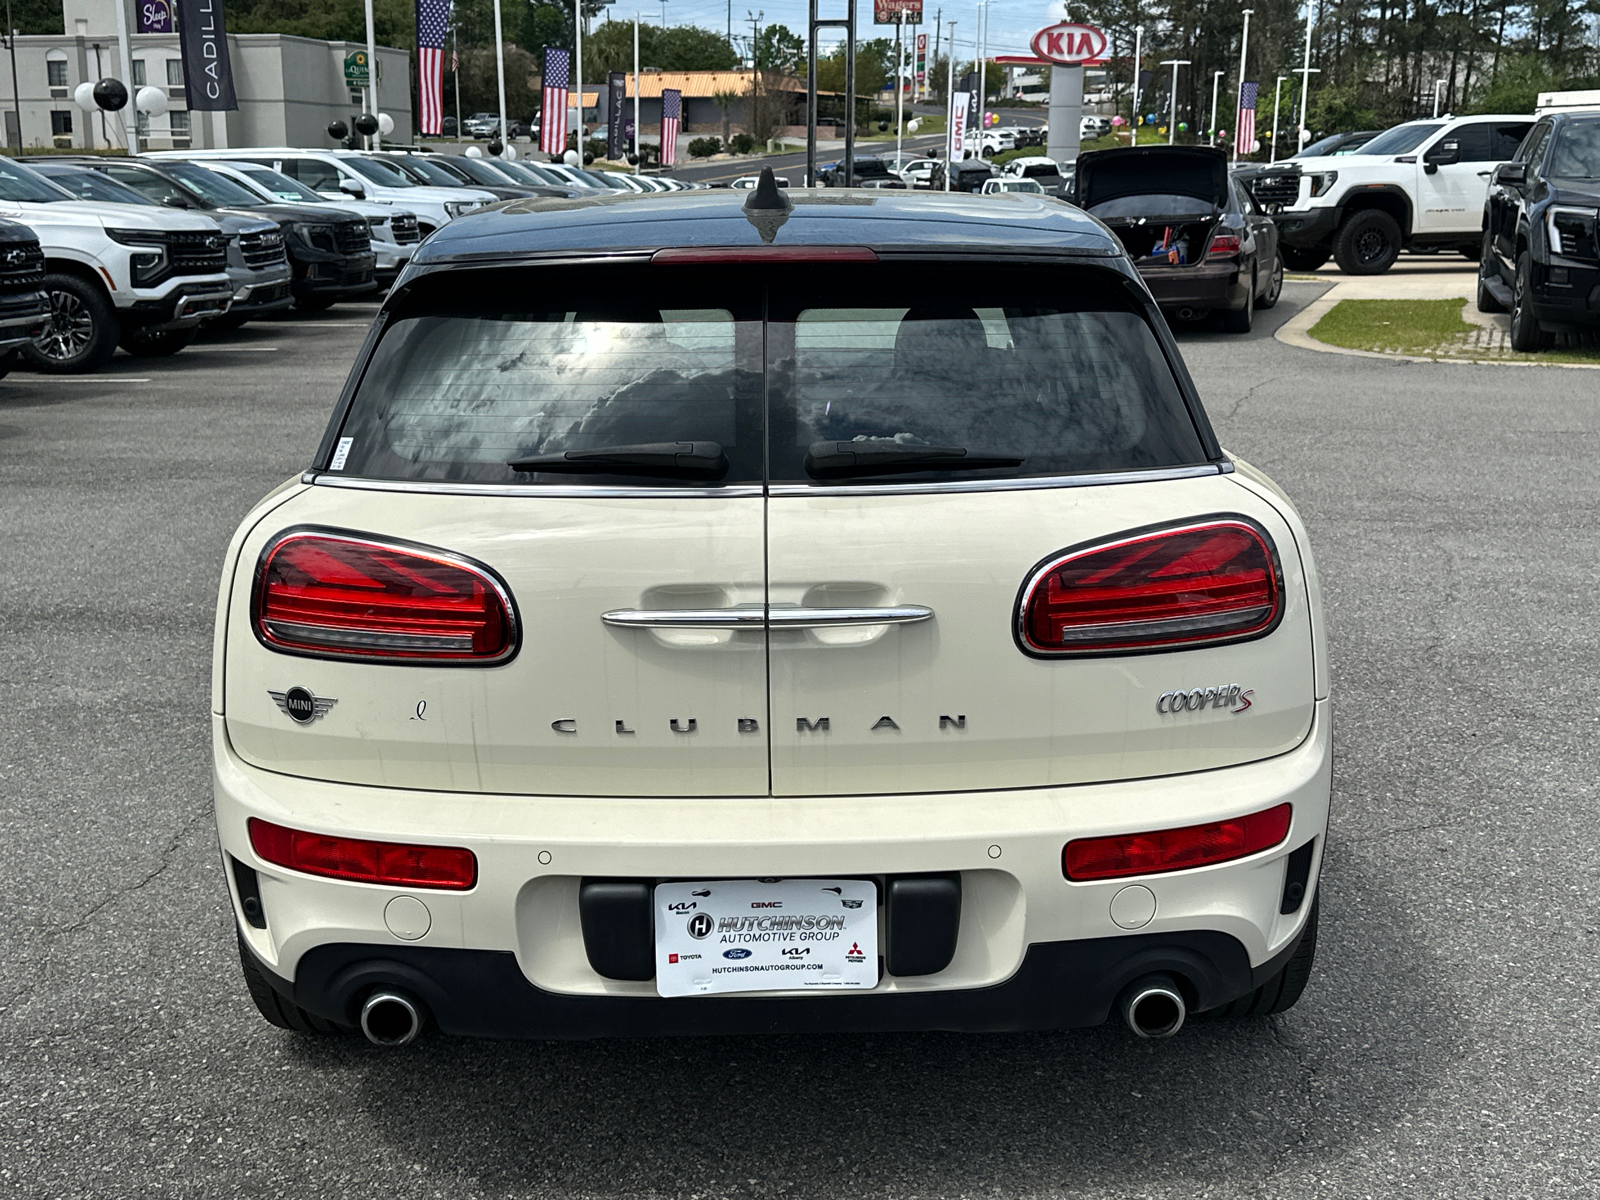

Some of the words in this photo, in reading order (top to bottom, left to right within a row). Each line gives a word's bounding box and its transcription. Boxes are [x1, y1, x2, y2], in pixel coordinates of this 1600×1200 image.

[877, 0, 921, 12] Wagers
[143, 3, 167, 26] Sleep
[1047, 32, 1094, 55] KIA
[954, 105, 964, 151] GMC
[288, 698, 312, 712] MINI
[551, 714, 967, 734] CLUBMAN
[751, 901, 783, 909] GMC
[717, 915, 845, 933] HUTCHINSON
[719, 932, 796, 944] AUTOMOTIVE
[799, 931, 840, 942] GROUP
[712, 964, 823, 974] HUTCHINSONAUTOGROUP.COM
